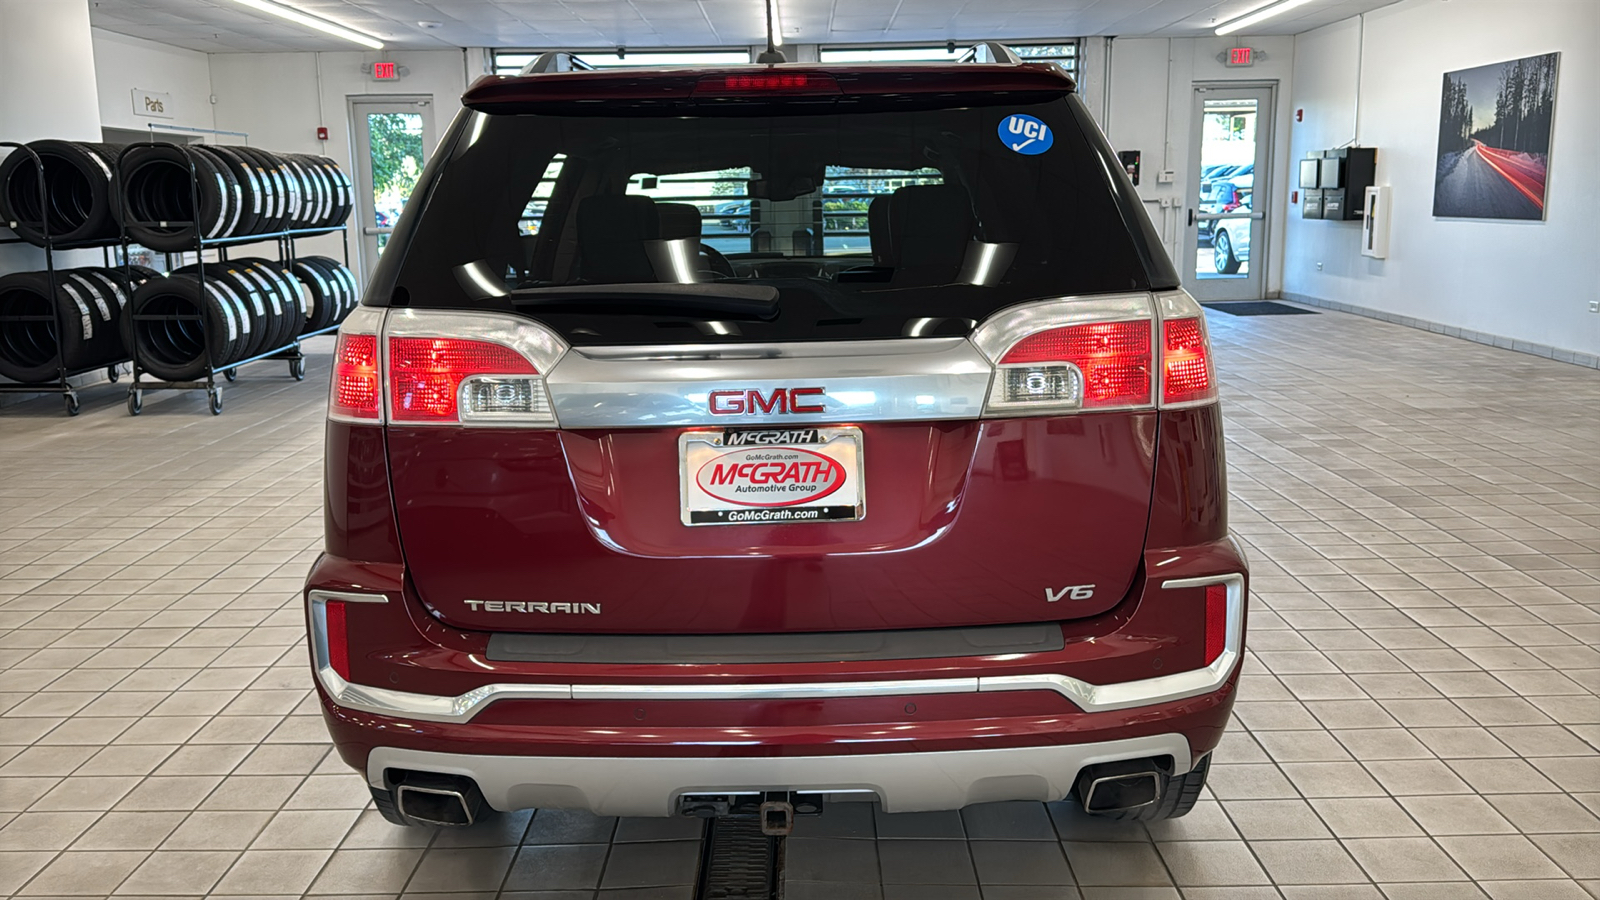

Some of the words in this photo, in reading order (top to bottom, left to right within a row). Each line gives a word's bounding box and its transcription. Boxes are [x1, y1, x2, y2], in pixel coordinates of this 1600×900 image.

[1231, 47, 1251, 64] EXIT
[374, 62, 395, 79] EXIT
[144, 96, 164, 113] Parts
[1008, 116, 1047, 141] UCI
[708, 387, 826, 416] GMC
[745, 453, 799, 461] GoMcGrath.com
[735, 485, 787, 493] Automotive
[788, 484, 817, 493] Group
[728, 510, 819, 521] GoMcGrath.com
[1045, 583, 1096, 602] V6
[463, 599, 601, 614] TERRAIN
